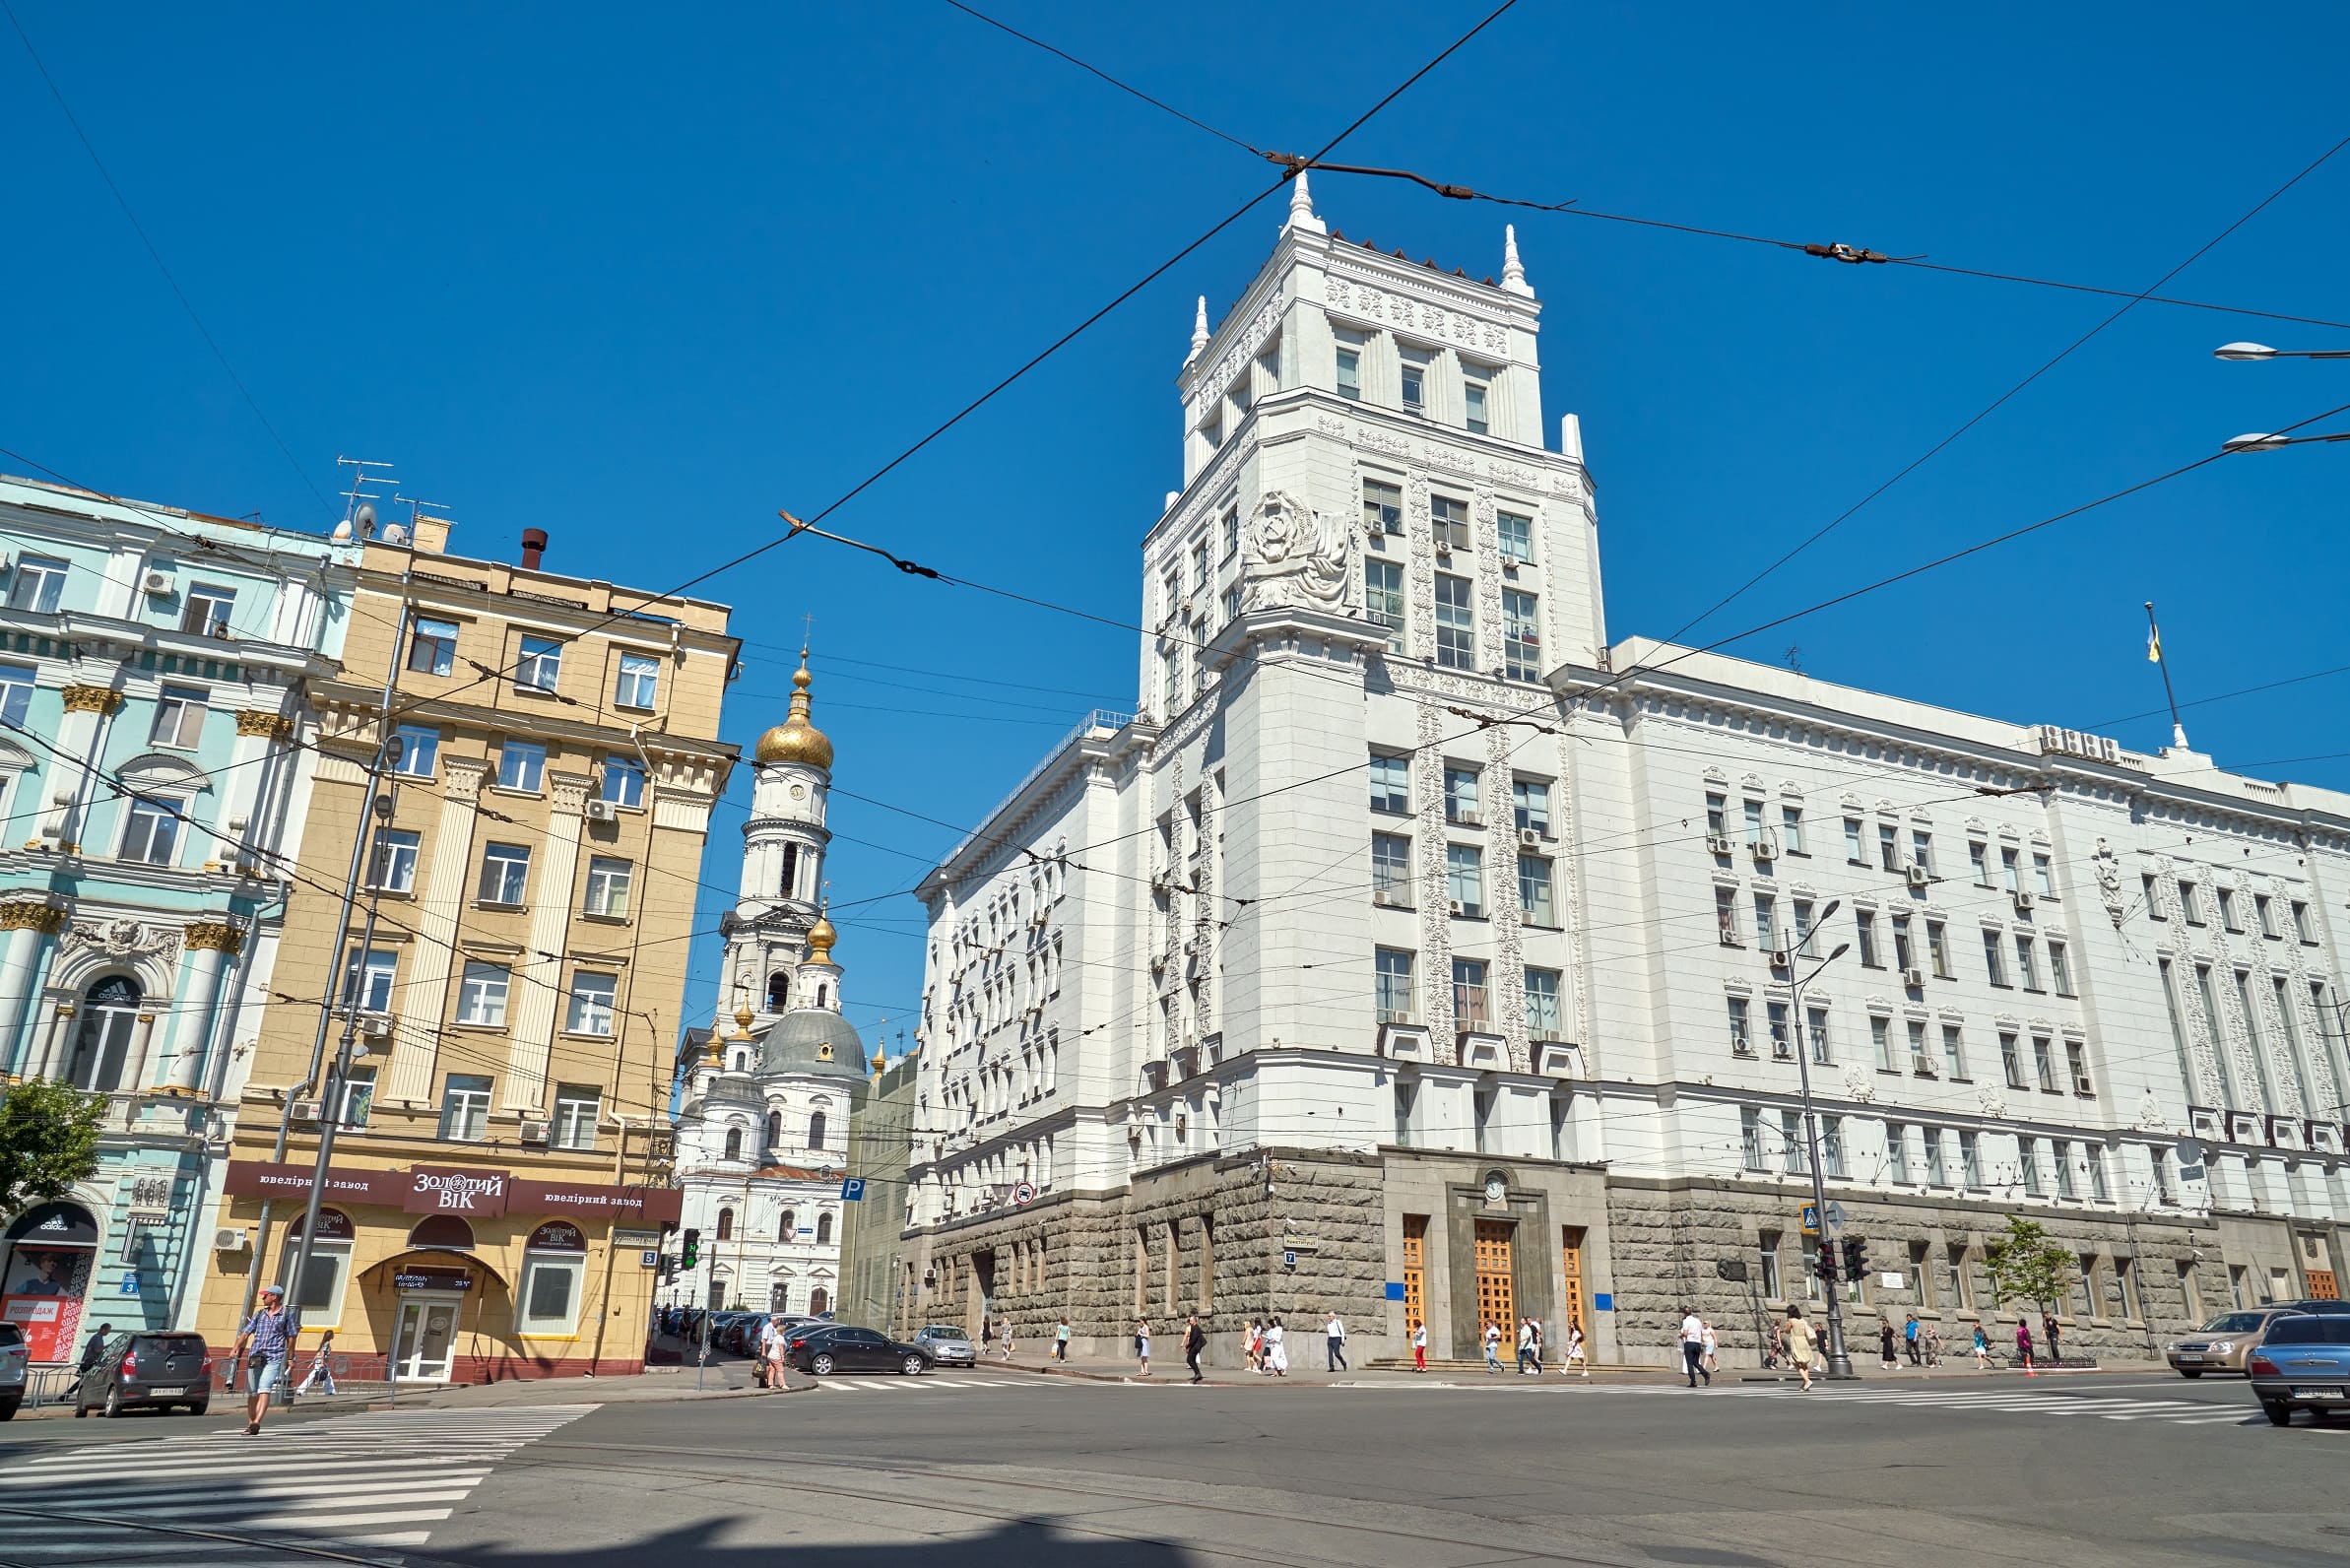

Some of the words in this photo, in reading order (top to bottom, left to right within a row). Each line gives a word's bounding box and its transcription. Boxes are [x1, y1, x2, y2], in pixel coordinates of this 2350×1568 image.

[98, 993, 131, 1002] adidas
[333, 1182, 369, 1192] завод
[845, 1179, 862, 1198] P
[438, 1190, 476, 1209] ВІК
[544, 1193, 608, 1206] ювелірний
[610, 1198, 643, 1208] завод
[645, 1253, 653, 1263] 5
[127, 1283, 134, 1292] 3
[9, 1305, 54, 1316] РОЗПРОДАЖ
